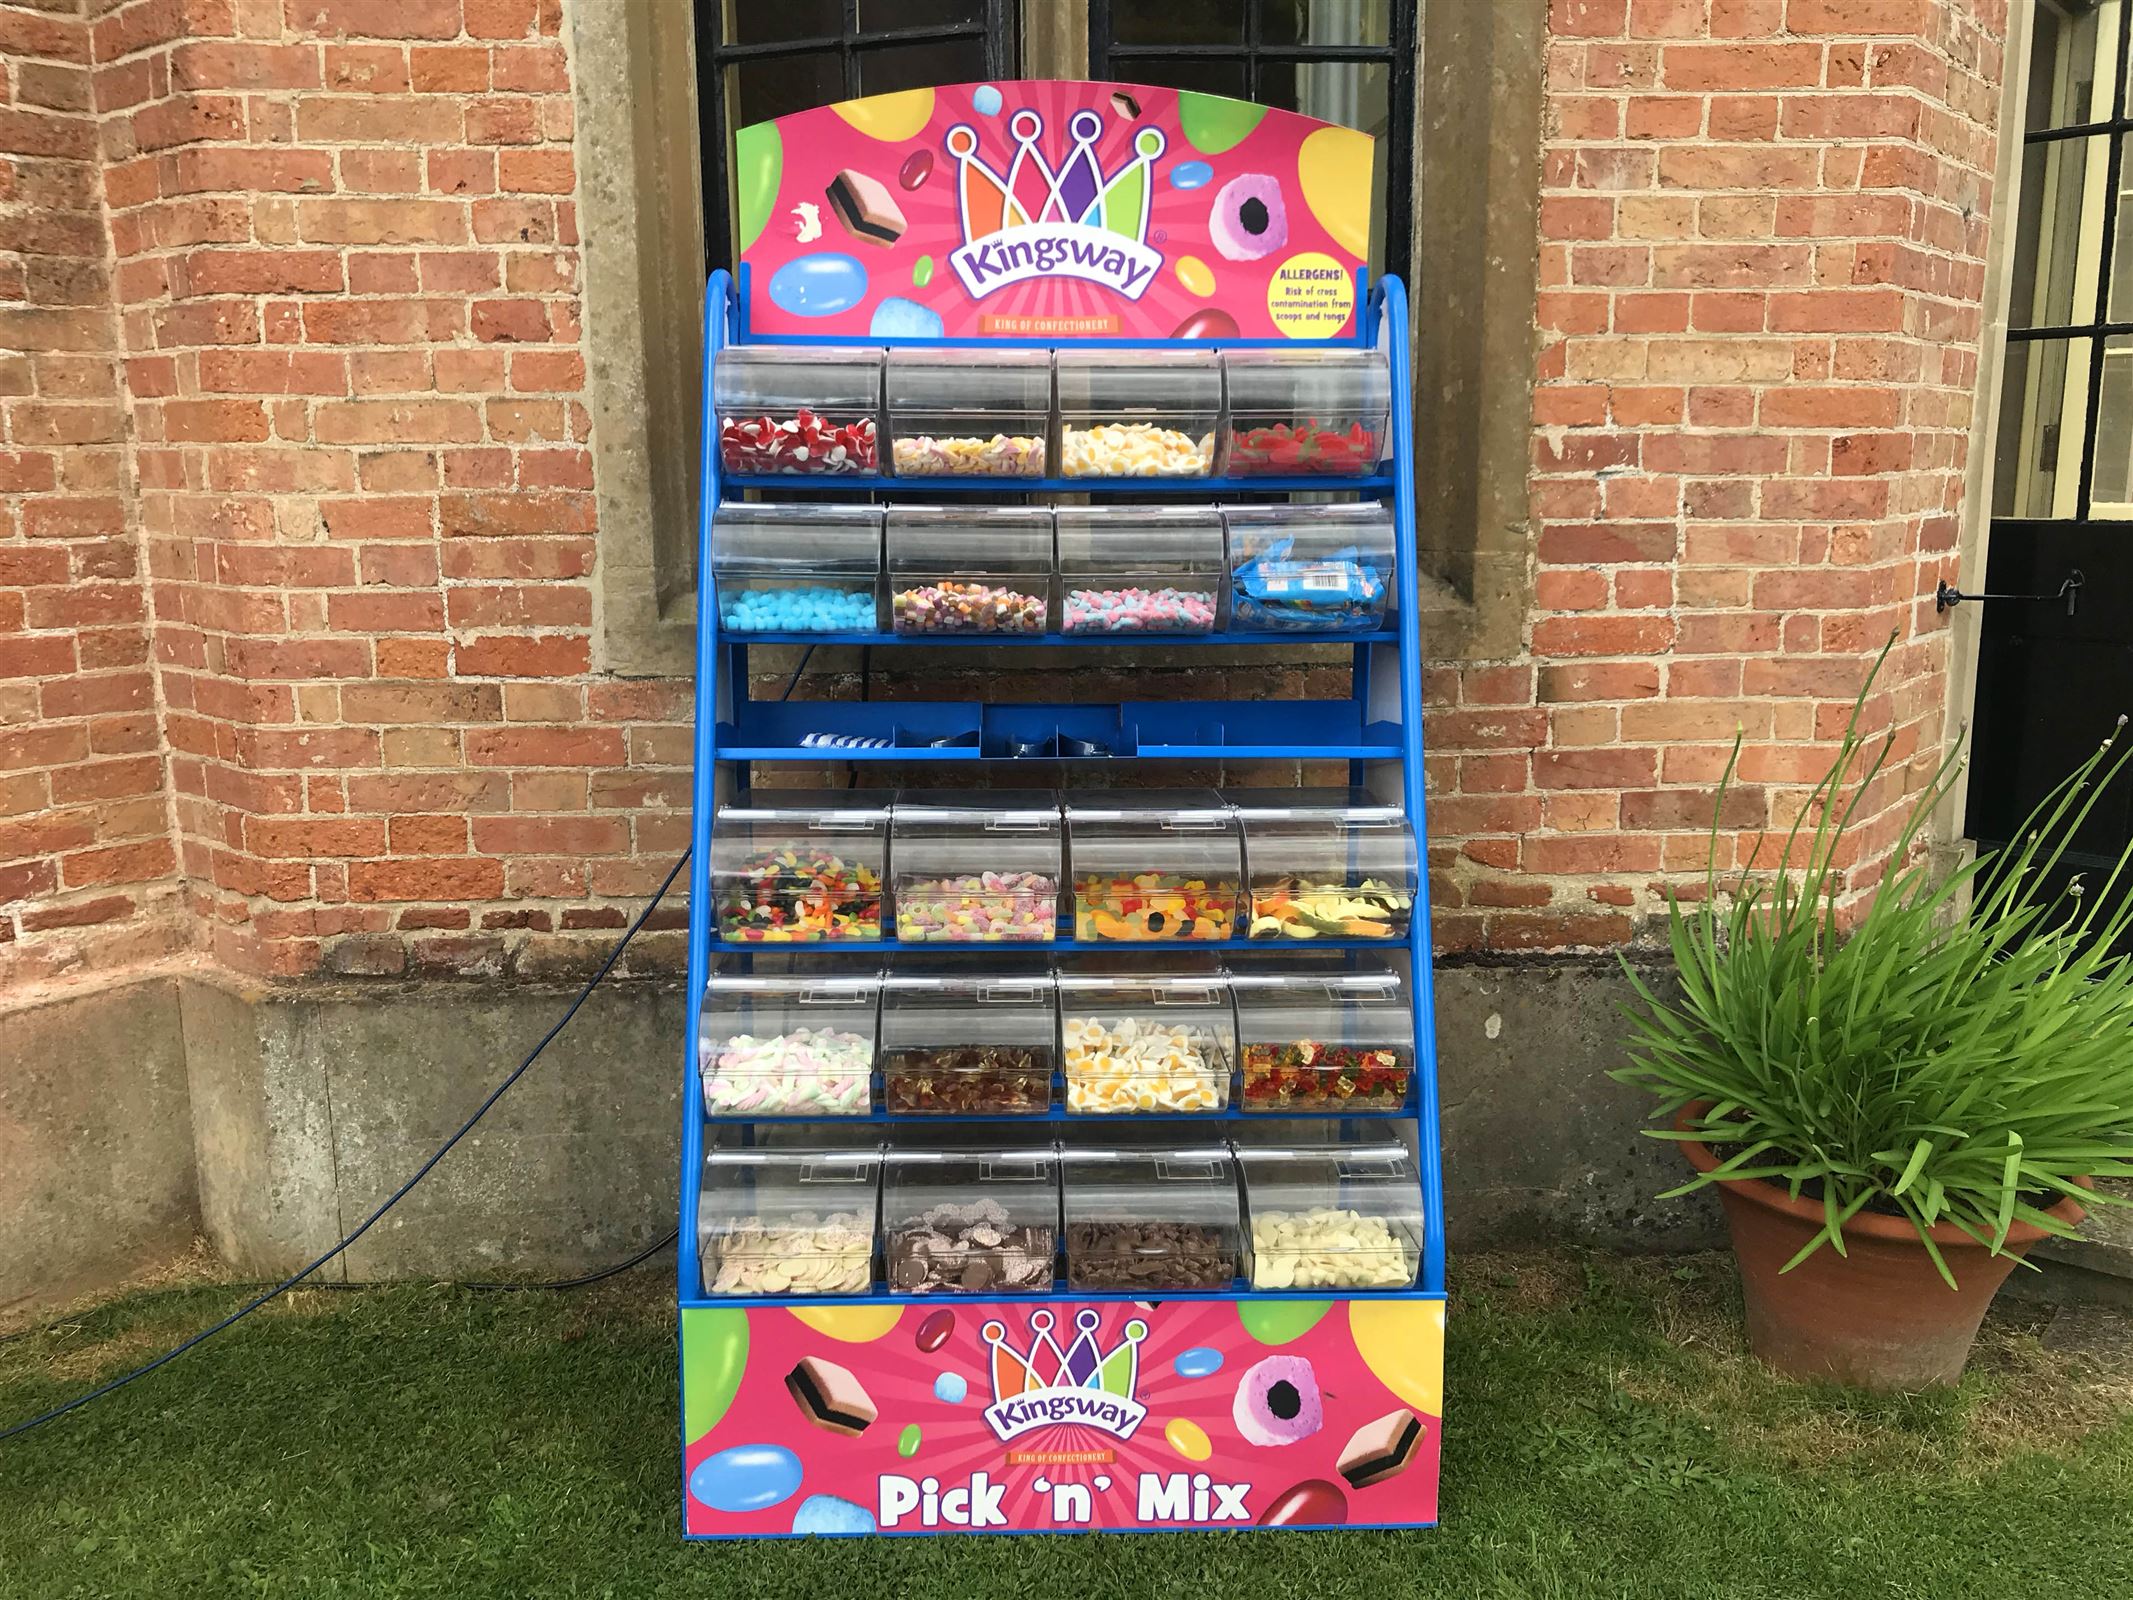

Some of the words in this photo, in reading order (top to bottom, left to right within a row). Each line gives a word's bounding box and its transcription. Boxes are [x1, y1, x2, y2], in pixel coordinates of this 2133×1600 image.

[962, 236, 1152, 291] Kingsway
[1280, 269, 1344, 280] ALLERGENS!
[1285, 287, 1302, 295] Risk
[1306, 286, 1314, 296] of
[1271, 299, 1328, 308] contamination
[1331, 298, 1351, 308] from
[1276, 313, 1302, 322] scoops
[1306, 312, 1320, 321] and
[1323, 313, 1345, 323] tongs
[994, 319, 1017, 330] KING
[1019, 320, 1031, 330] OF
[1034, 319, 1109, 331] CONFECTIONERY
[993, 1396, 1139, 1433] Kingsway
[1018, 1454, 1036, 1463] KING
[1037, 1453, 1047, 1463] OF
[1048, 1452, 1106, 1463] CONFECTIONERY
[878, 1474, 1007, 1528] Pick
[1137, 1474, 1251, 1523] Mix
